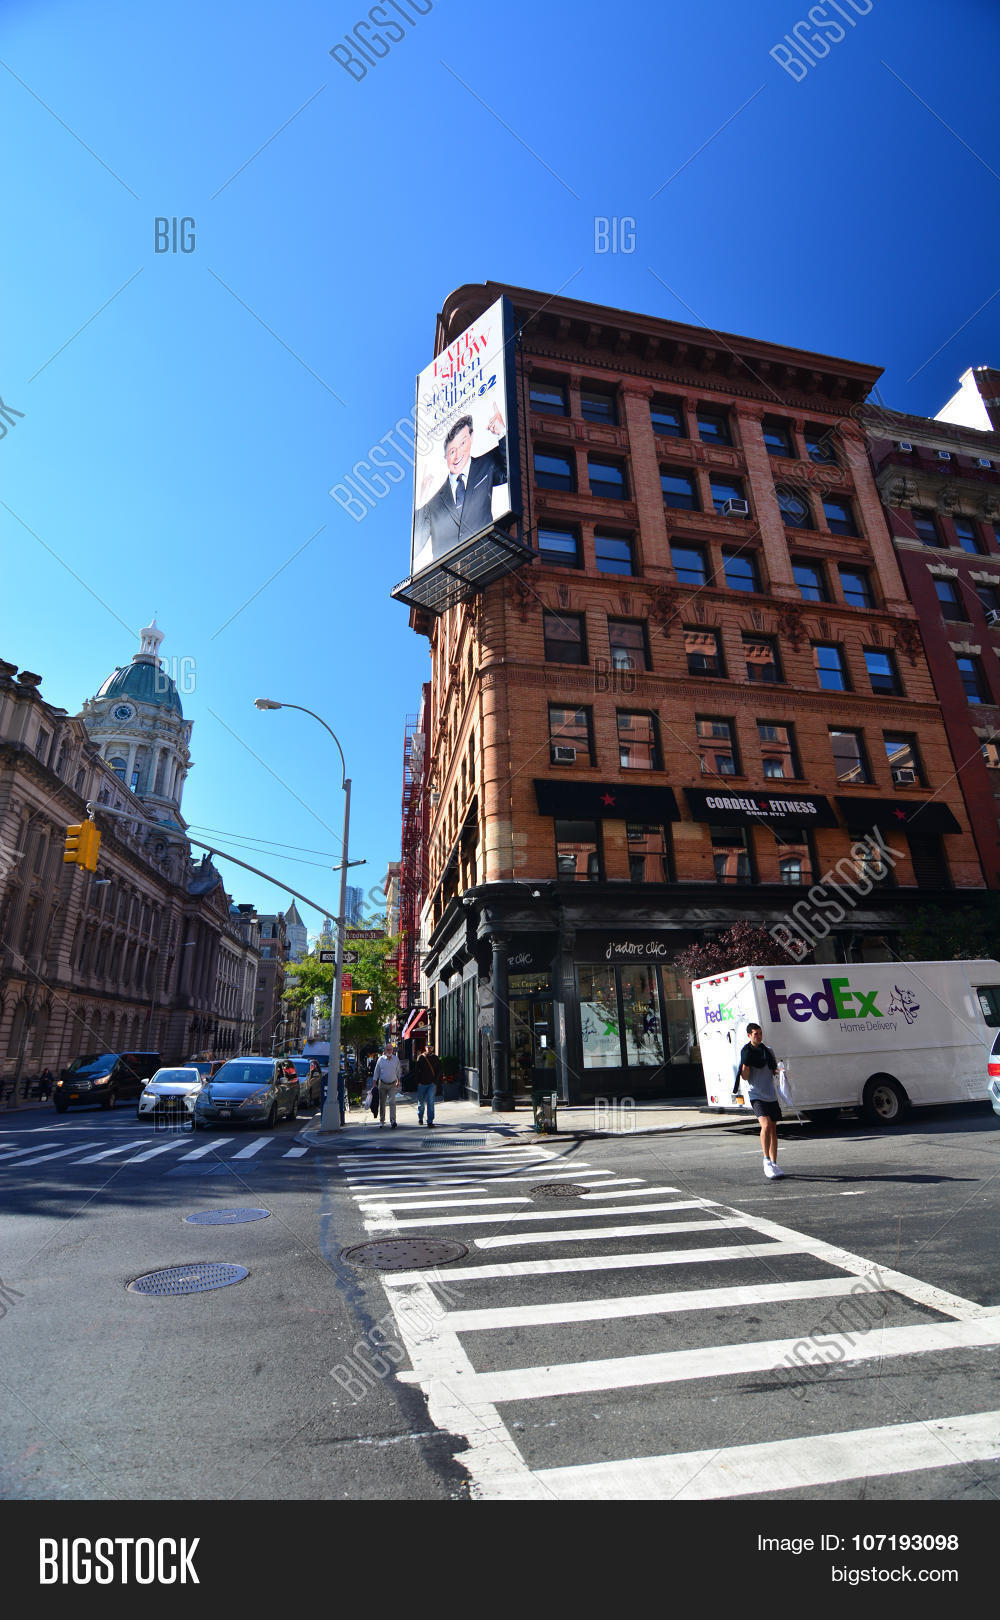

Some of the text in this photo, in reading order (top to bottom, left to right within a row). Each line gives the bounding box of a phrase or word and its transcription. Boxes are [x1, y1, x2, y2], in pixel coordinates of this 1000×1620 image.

[433, 327, 477, 377] LATE
[440, 327, 494, 386] SHOW
[705, 796, 817, 814] CORDELL FITNESS
[605, 941, 667, 959] j'adore clic
[764, 977, 885, 1022] FedEx
[704, 1002, 735, 1024] FedEx
[840, 1021, 897, 1032] Home Delivery
